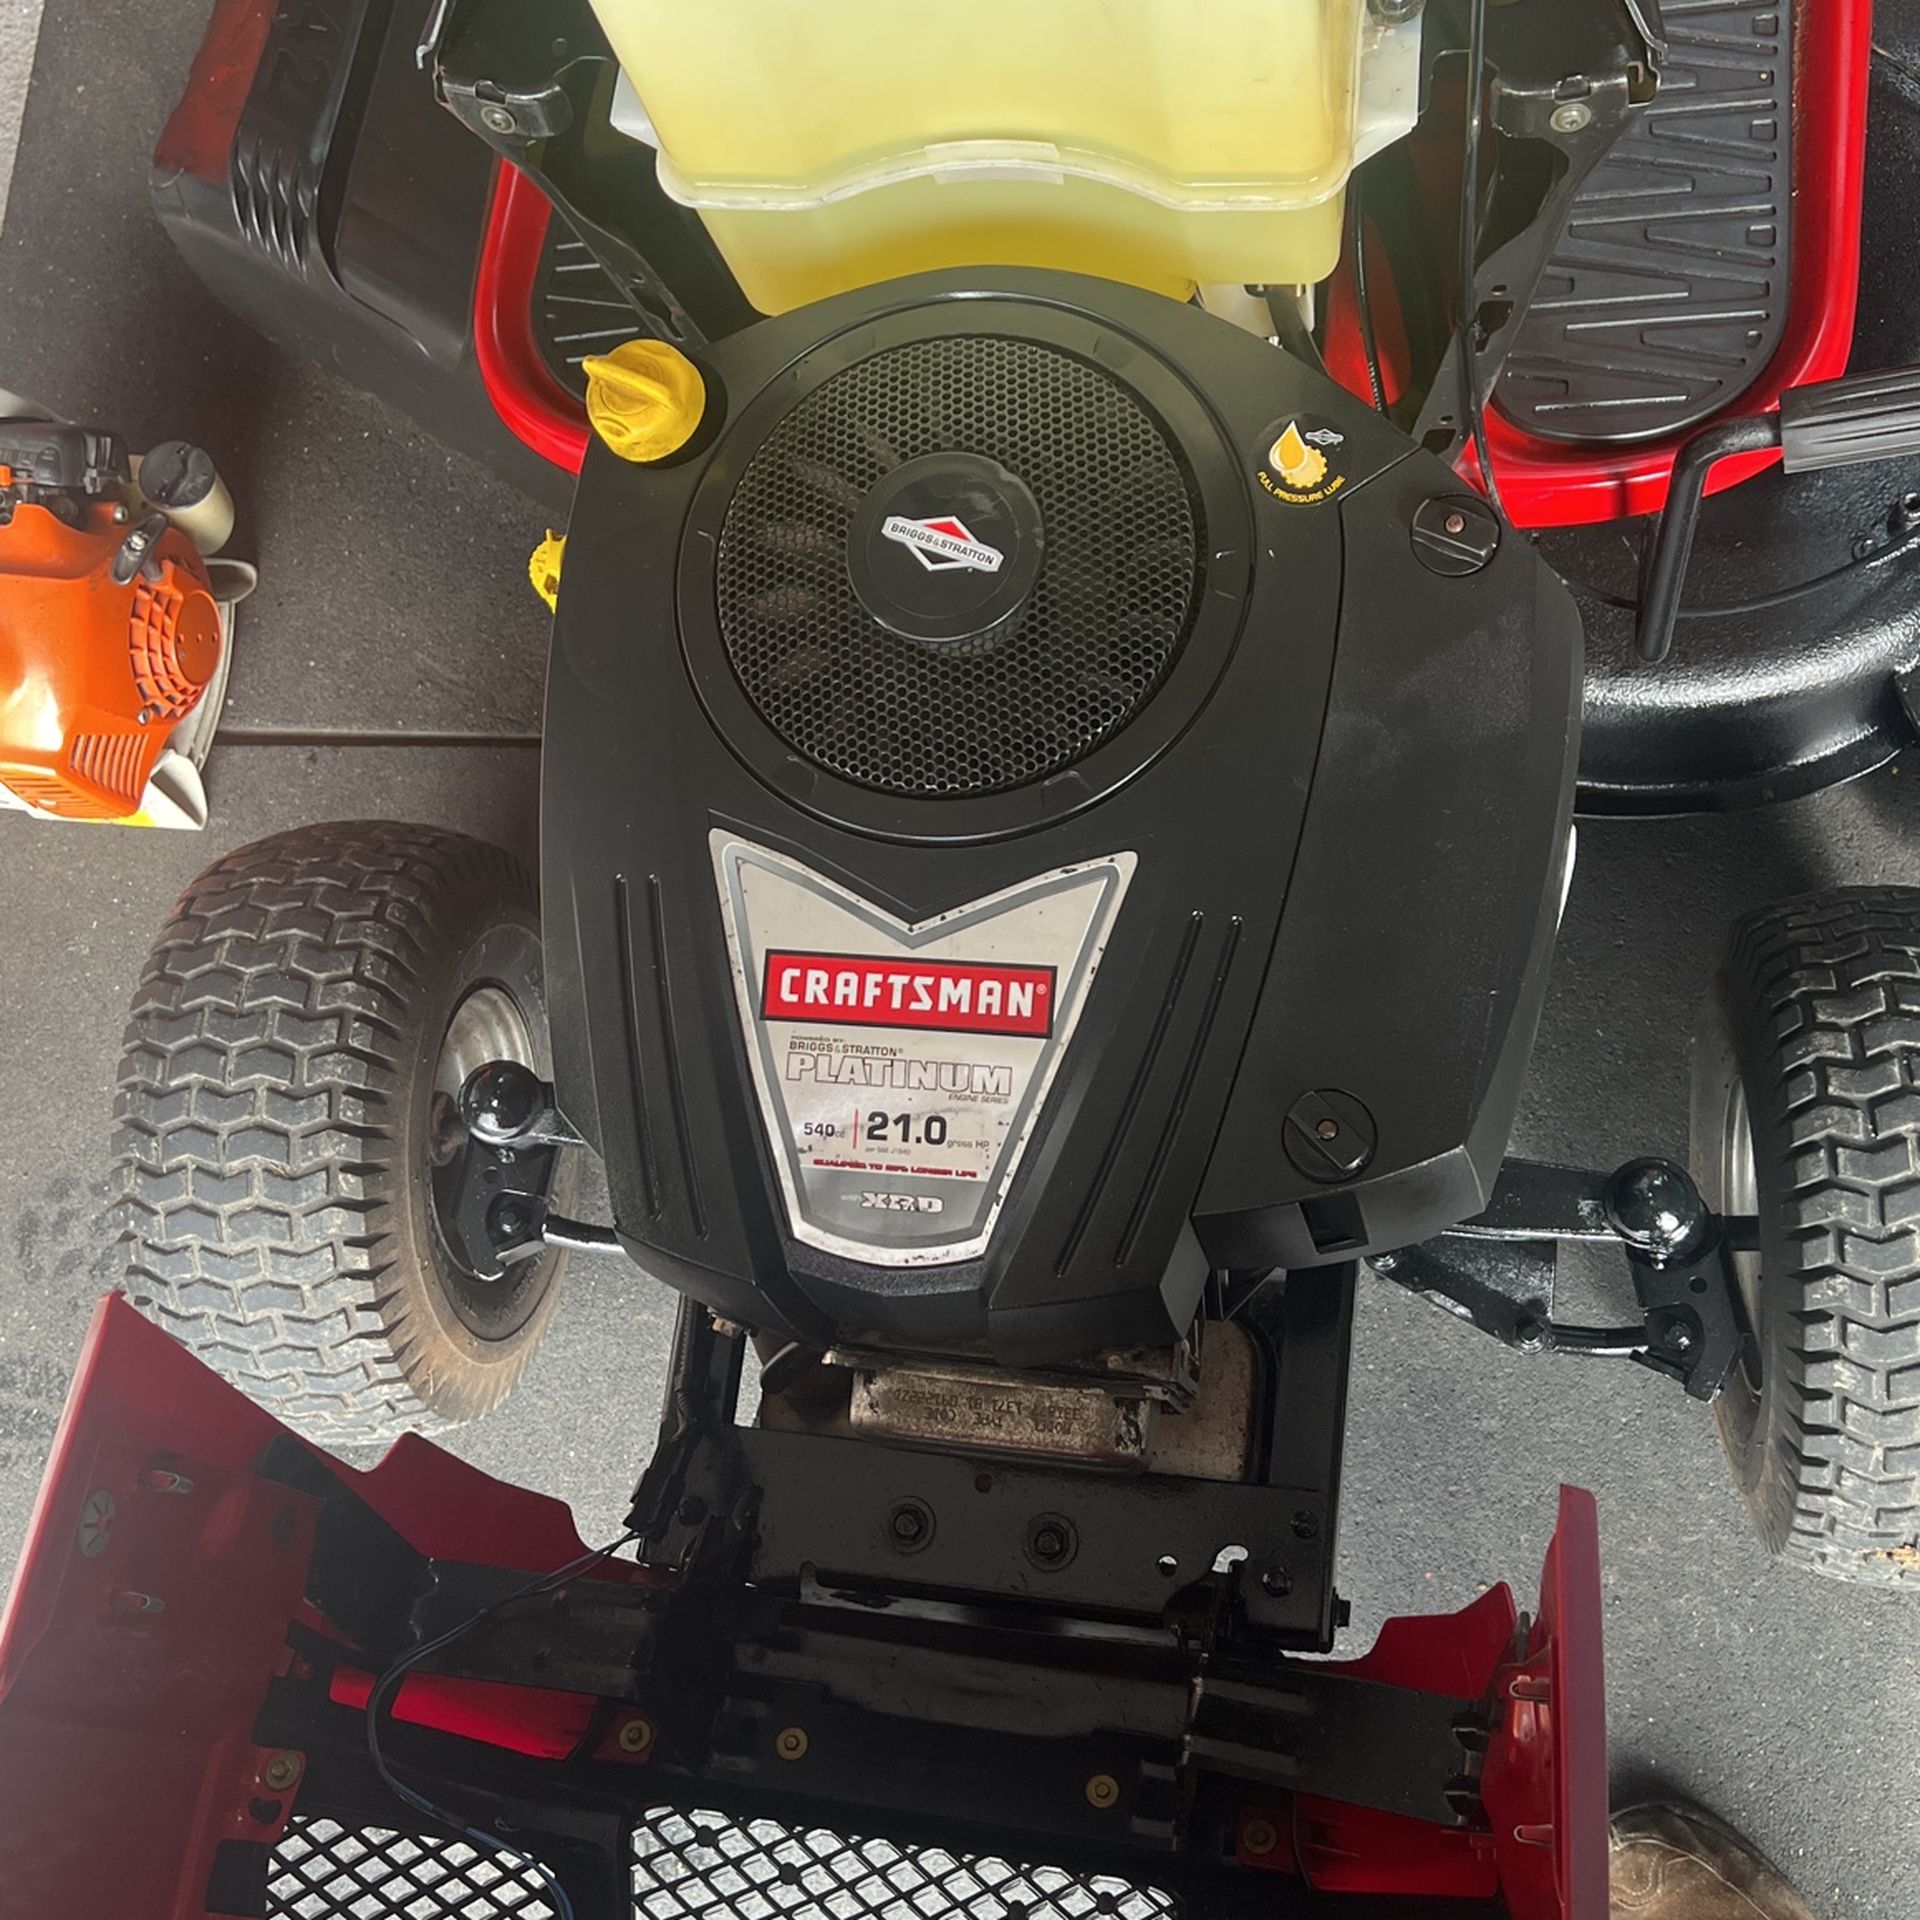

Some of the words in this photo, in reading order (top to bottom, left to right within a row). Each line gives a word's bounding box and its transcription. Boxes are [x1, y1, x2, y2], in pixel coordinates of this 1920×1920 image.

[890, 522, 995, 565] BRIGGS&STRATTON
[786, 1052, 1013, 1096] PLATINUM
[866, 1111, 947, 1146] 21.0
